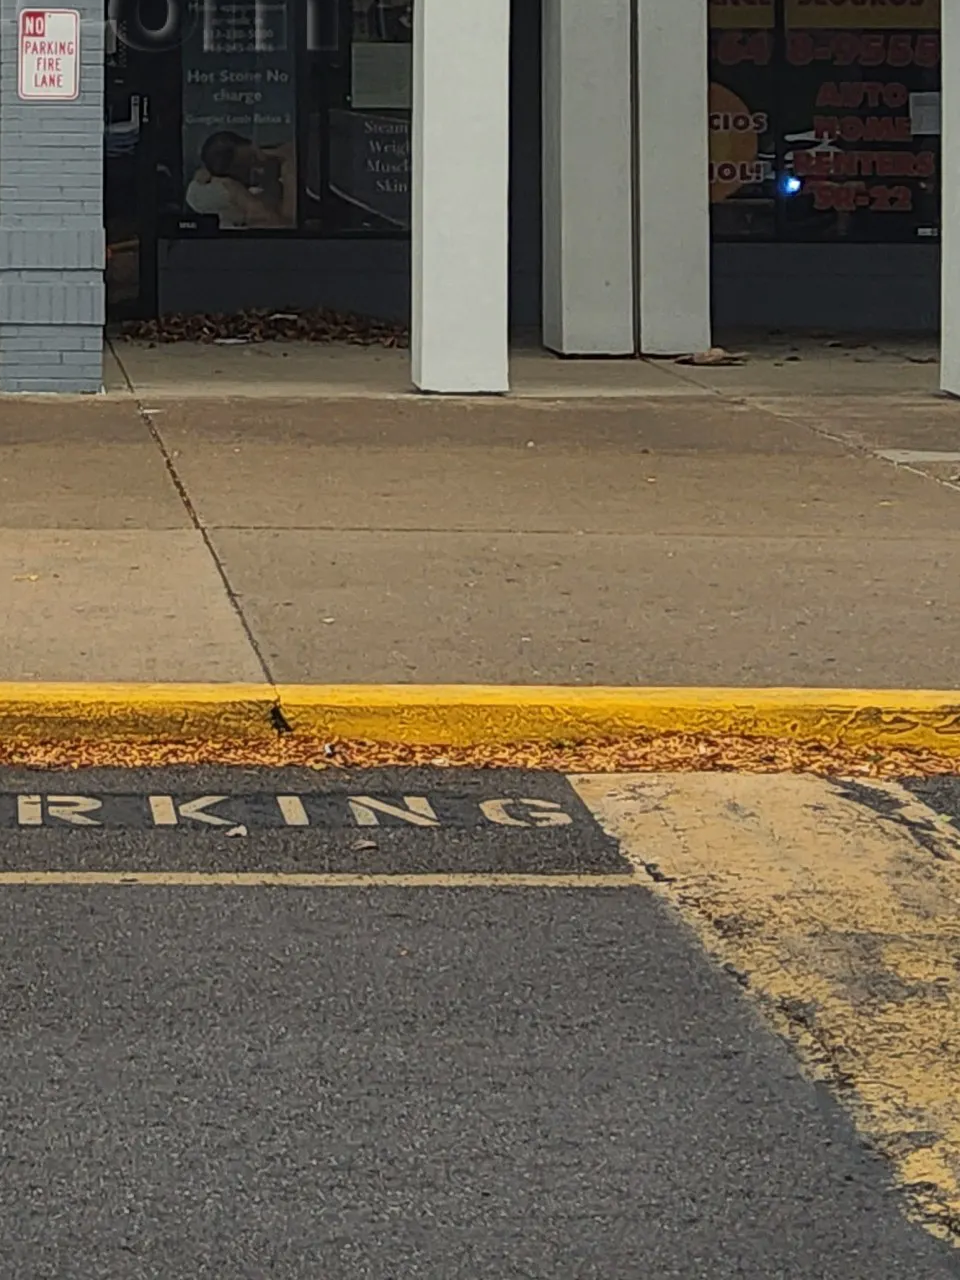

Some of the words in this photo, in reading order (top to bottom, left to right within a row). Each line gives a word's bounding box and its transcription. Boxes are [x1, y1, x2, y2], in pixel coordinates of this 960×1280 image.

[24, 16, 44, 36] NO
[24, 41, 74, 55] PARKING
[36, 57, 61, 72] FIRE
[34, 74, 62, 88] LANE
[187, 69, 214, 83] Hot
[219, 69, 262, 83] Stone
[266, 69, 288, 83] No
[213, 87, 262, 105] charge
[815, 82, 907, 108] AUTO
[813, 116, 912, 141] HOME
[793, 152, 934, 177] RENTERS
[376, 179, 408, 193] Skin
